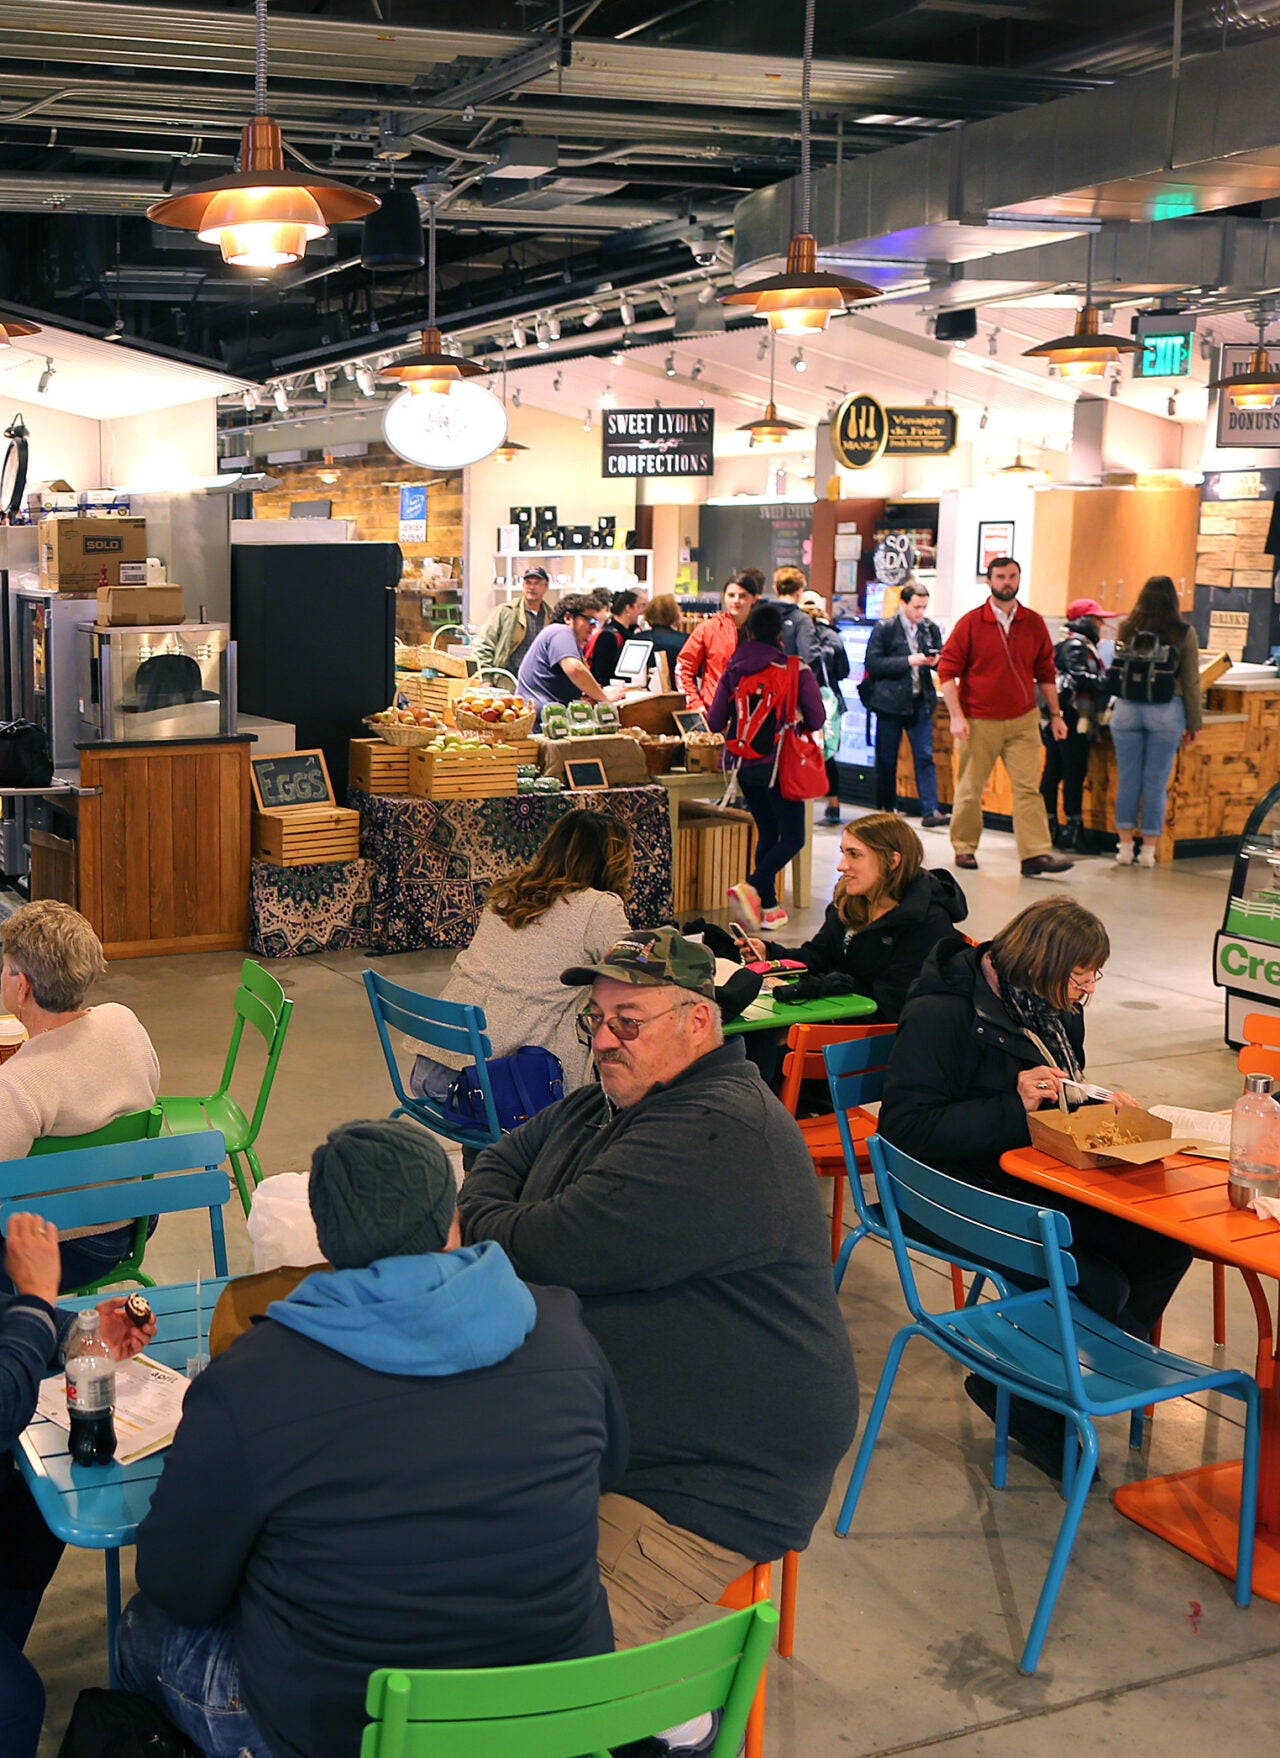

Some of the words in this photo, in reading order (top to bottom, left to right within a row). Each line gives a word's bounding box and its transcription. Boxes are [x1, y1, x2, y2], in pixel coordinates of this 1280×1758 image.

[1142, 336, 1185, 376] EXIT
[608, 414, 654, 435] SWEET
[658, 413, 709, 434] LYDIA'S
[1228, 412, 1280, 431] DONUTS
[608, 454, 708, 474] CONFECTIONS
[86, 540, 120, 550] SOLO
[1220, 942, 1280, 987] Cre
